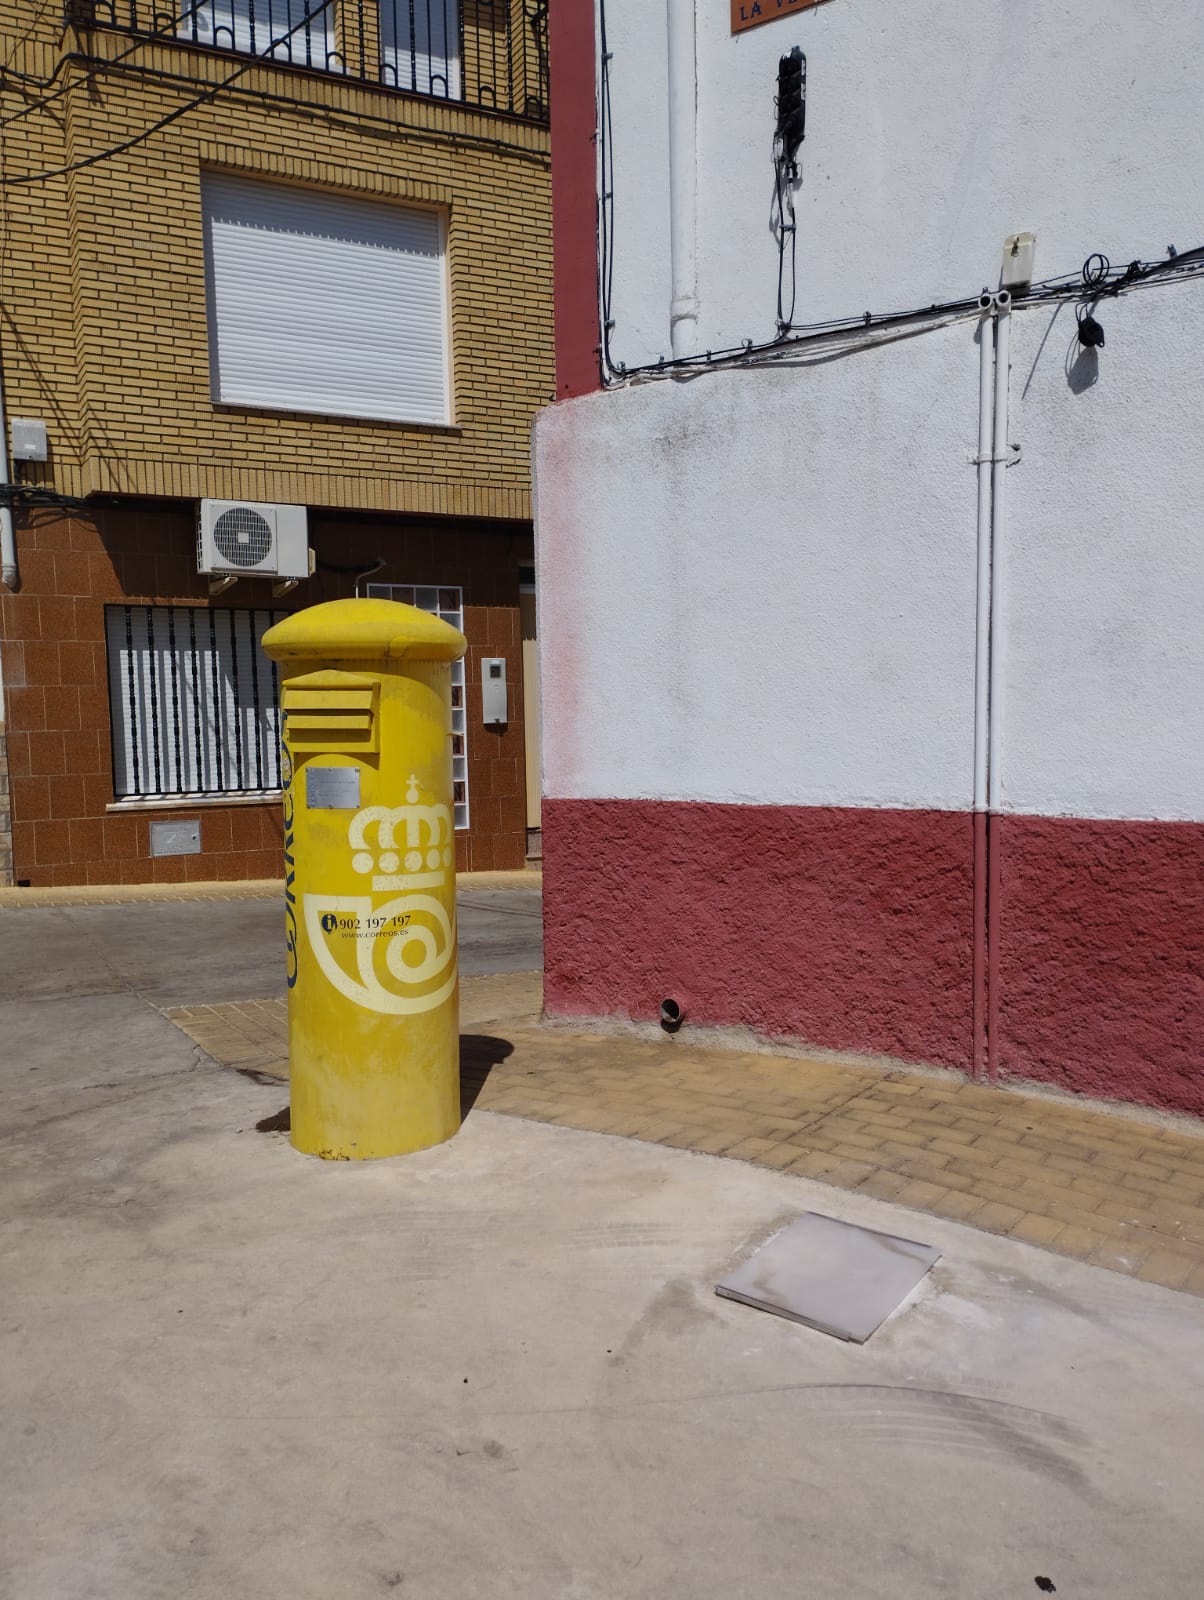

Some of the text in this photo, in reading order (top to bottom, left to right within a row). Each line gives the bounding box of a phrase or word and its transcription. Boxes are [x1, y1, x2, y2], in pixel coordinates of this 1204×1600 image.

[340, 915, 411, 930] 902 197 197
[341, 929, 409, 938] www.correos.es
